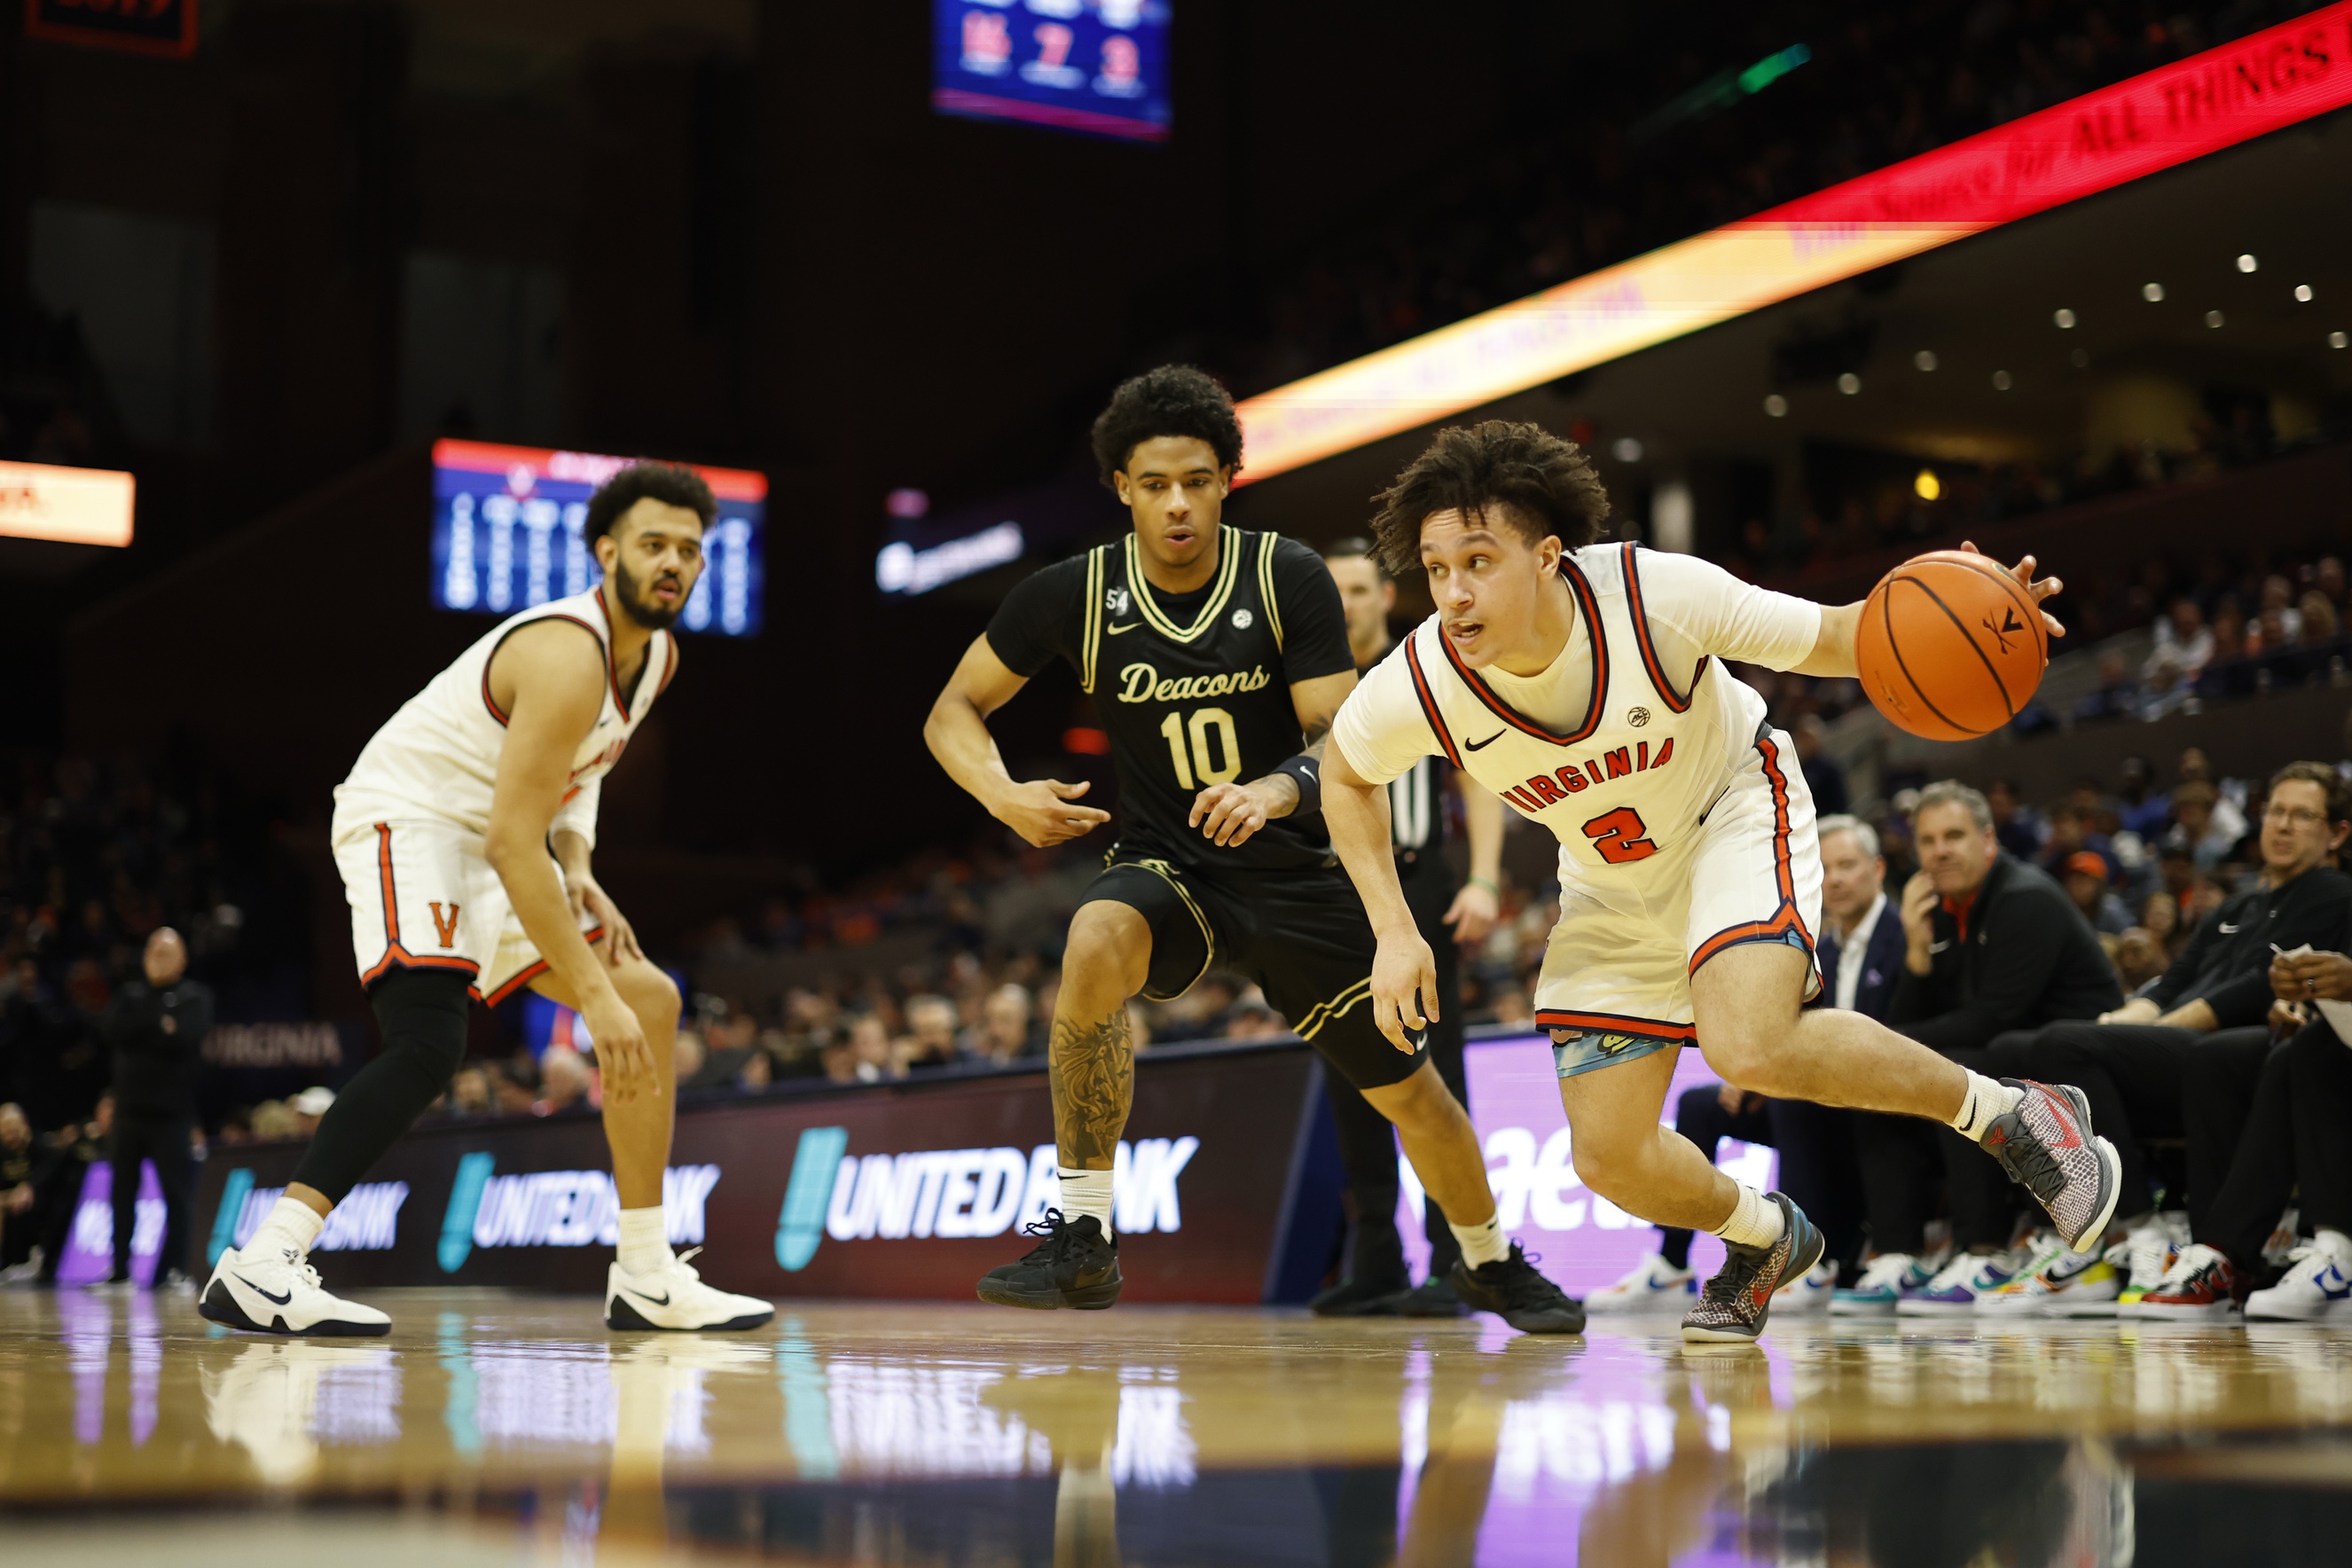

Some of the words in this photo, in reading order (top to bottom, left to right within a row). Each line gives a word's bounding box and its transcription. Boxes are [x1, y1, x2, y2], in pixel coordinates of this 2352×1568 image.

[2066, 96, 2152, 158] ALL
[2162, 28, 2332, 131] THINGS
[1105, 588, 1130, 612] 54
[1117, 662, 1271, 703] Deacons
[1160, 707, 1242, 790] 10
[1580, 806, 1658, 865] 2
[428, 901, 460, 949] V
